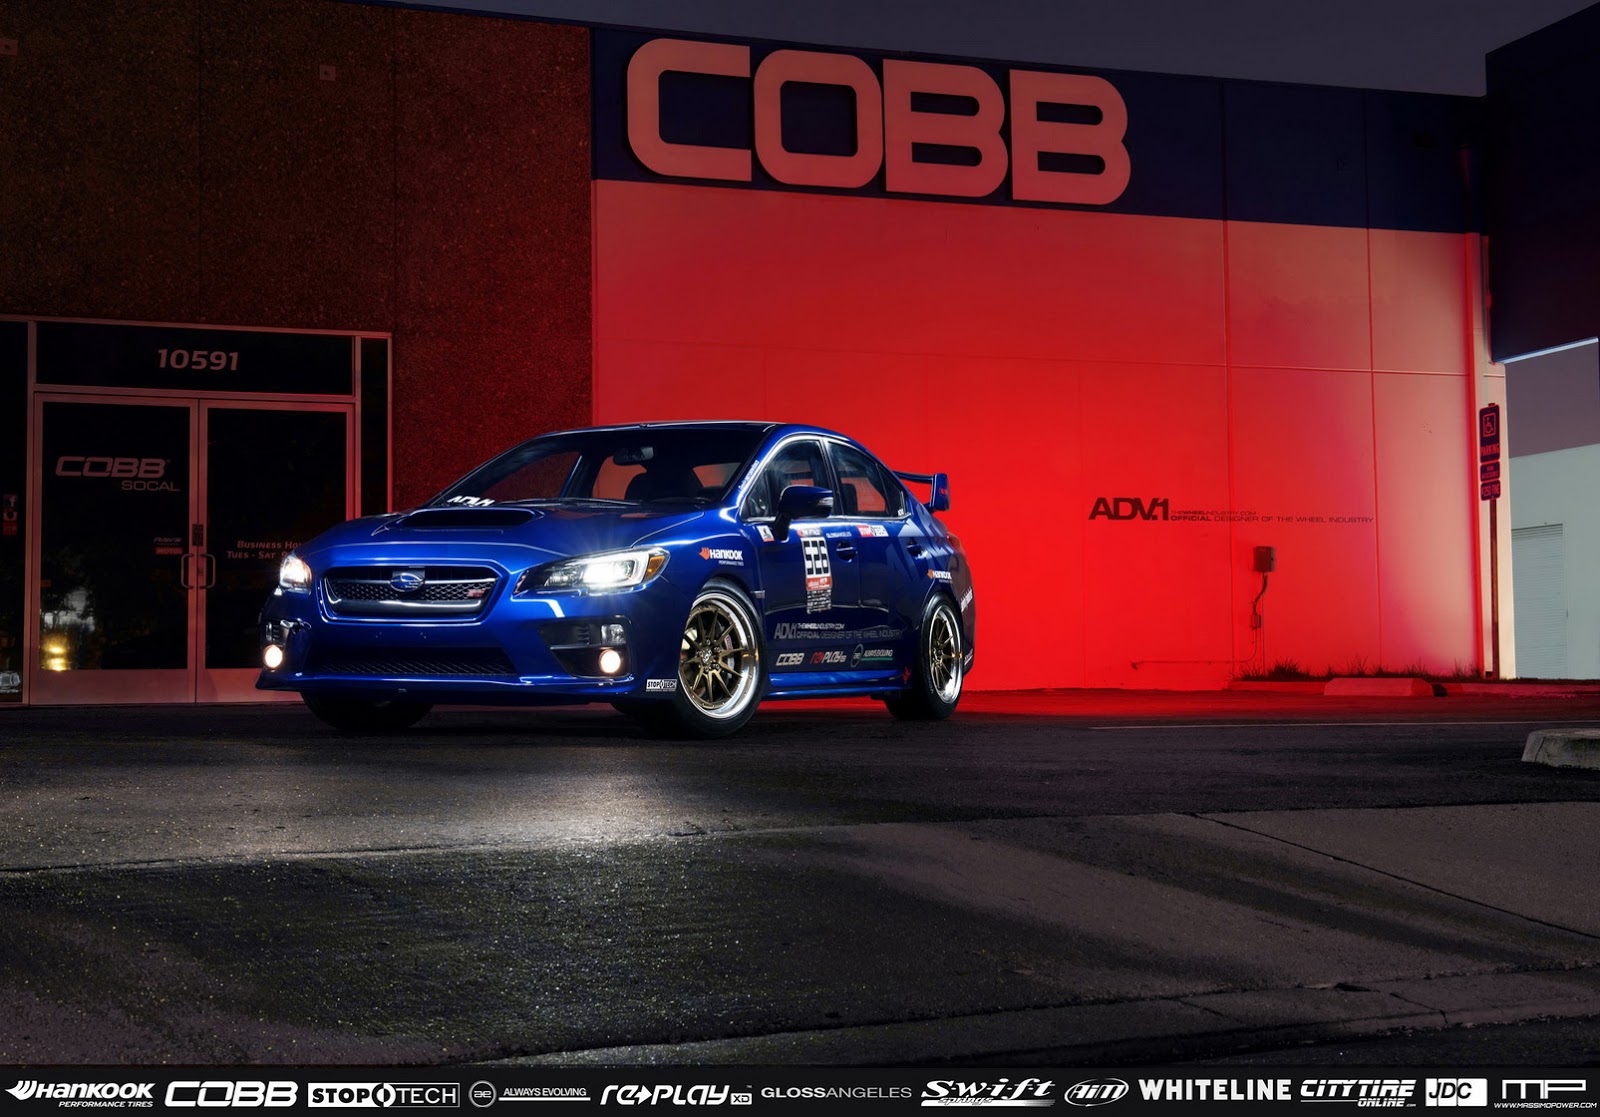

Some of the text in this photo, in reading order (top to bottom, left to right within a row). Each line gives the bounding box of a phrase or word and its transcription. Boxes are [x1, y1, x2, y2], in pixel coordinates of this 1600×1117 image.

[627, 38, 1131, 206] COBB
[157, 348, 239, 371] 10591
[55, 456, 167, 479] COBB
[121, 480, 180, 492] SOCAL
[1089, 497, 1169, 521] ADV.1
[237, 540, 282, 549] BUSINESS
[227, 551, 250, 559] TUES
[258, 551, 275, 559] SAT
[775, 652, 805, 666] COBB
